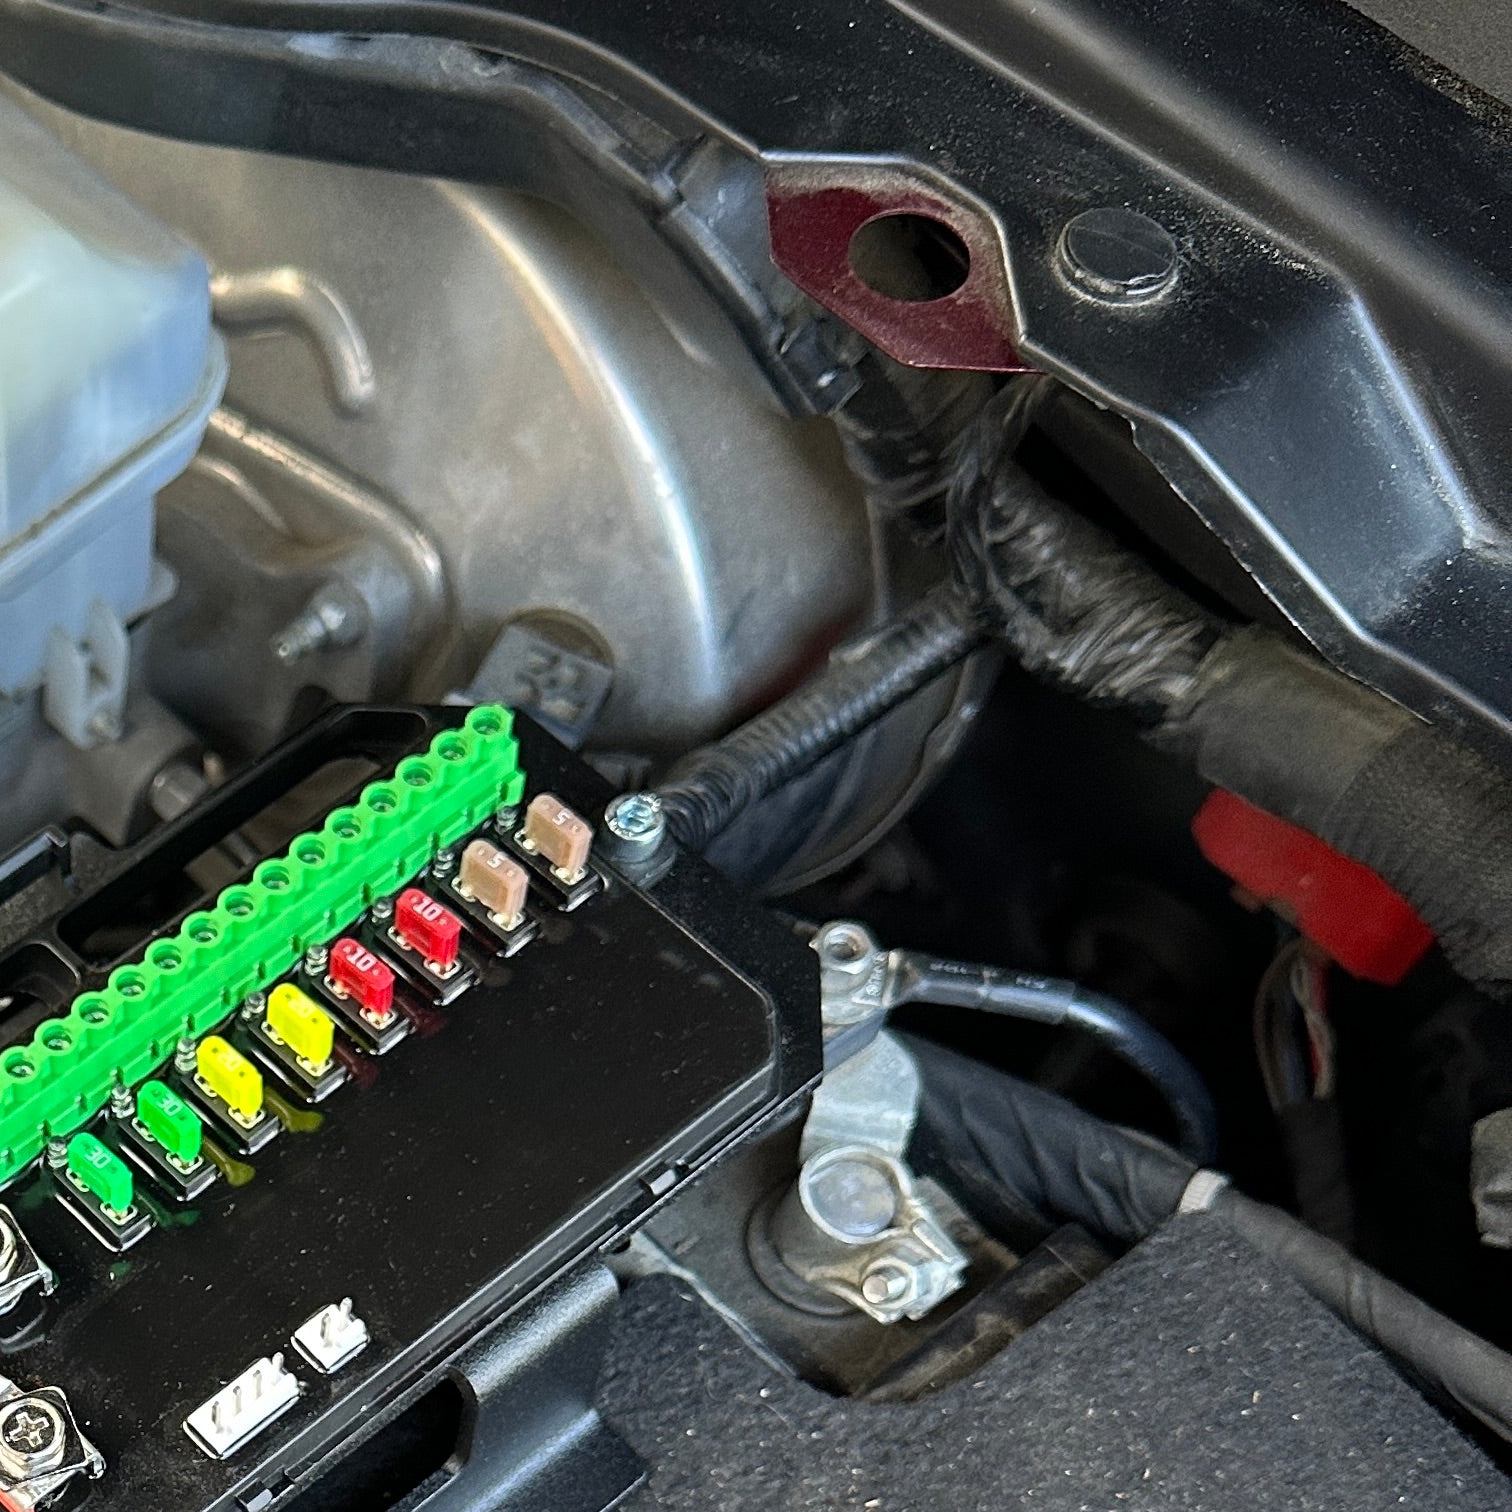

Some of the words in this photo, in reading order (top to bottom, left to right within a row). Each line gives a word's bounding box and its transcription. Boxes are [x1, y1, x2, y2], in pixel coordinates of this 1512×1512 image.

[551, 808, 571, 826] 5
[486, 851, 506, 869] 5
[412, 896, 444, 922] 10
[346, 947, 377, 972] 10
[156, 1093, 184, 1117] 30
[84, 1145, 111, 1169] 30
